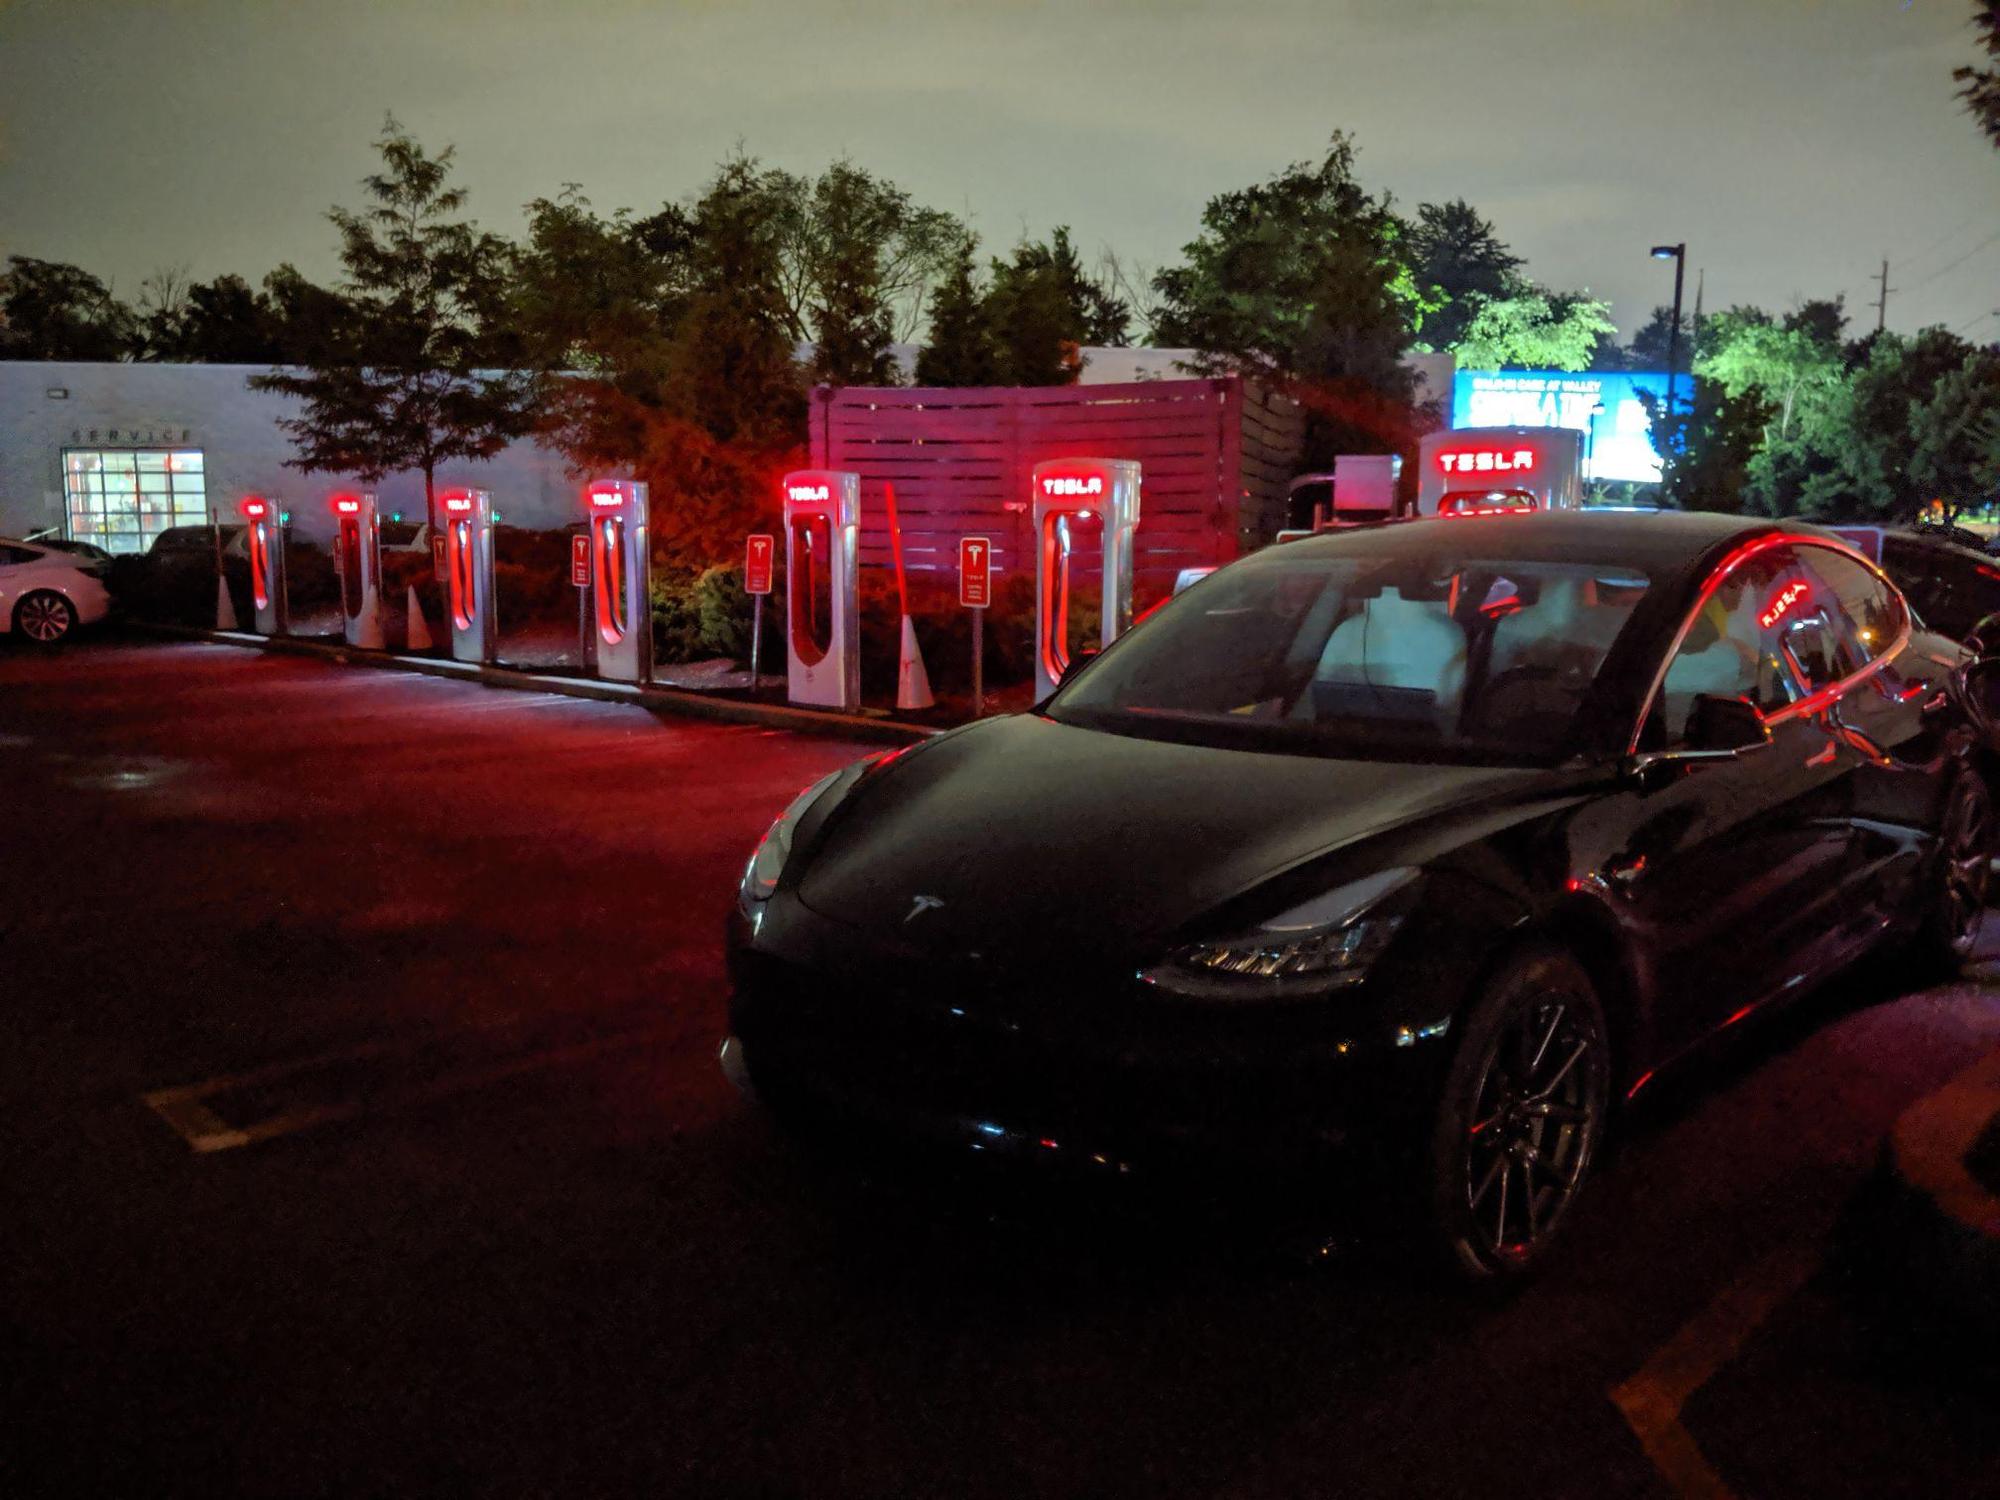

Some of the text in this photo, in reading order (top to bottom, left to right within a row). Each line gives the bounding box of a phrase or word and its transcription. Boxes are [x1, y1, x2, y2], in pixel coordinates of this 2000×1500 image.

[1562, 379, 1601, 393] VALLEY
[72, 429, 191, 442] SERVICE
[1440, 451, 1533, 472] TESLA
[788, 485, 829, 501] TESLA
[1043, 478, 1102, 495] TESLA
